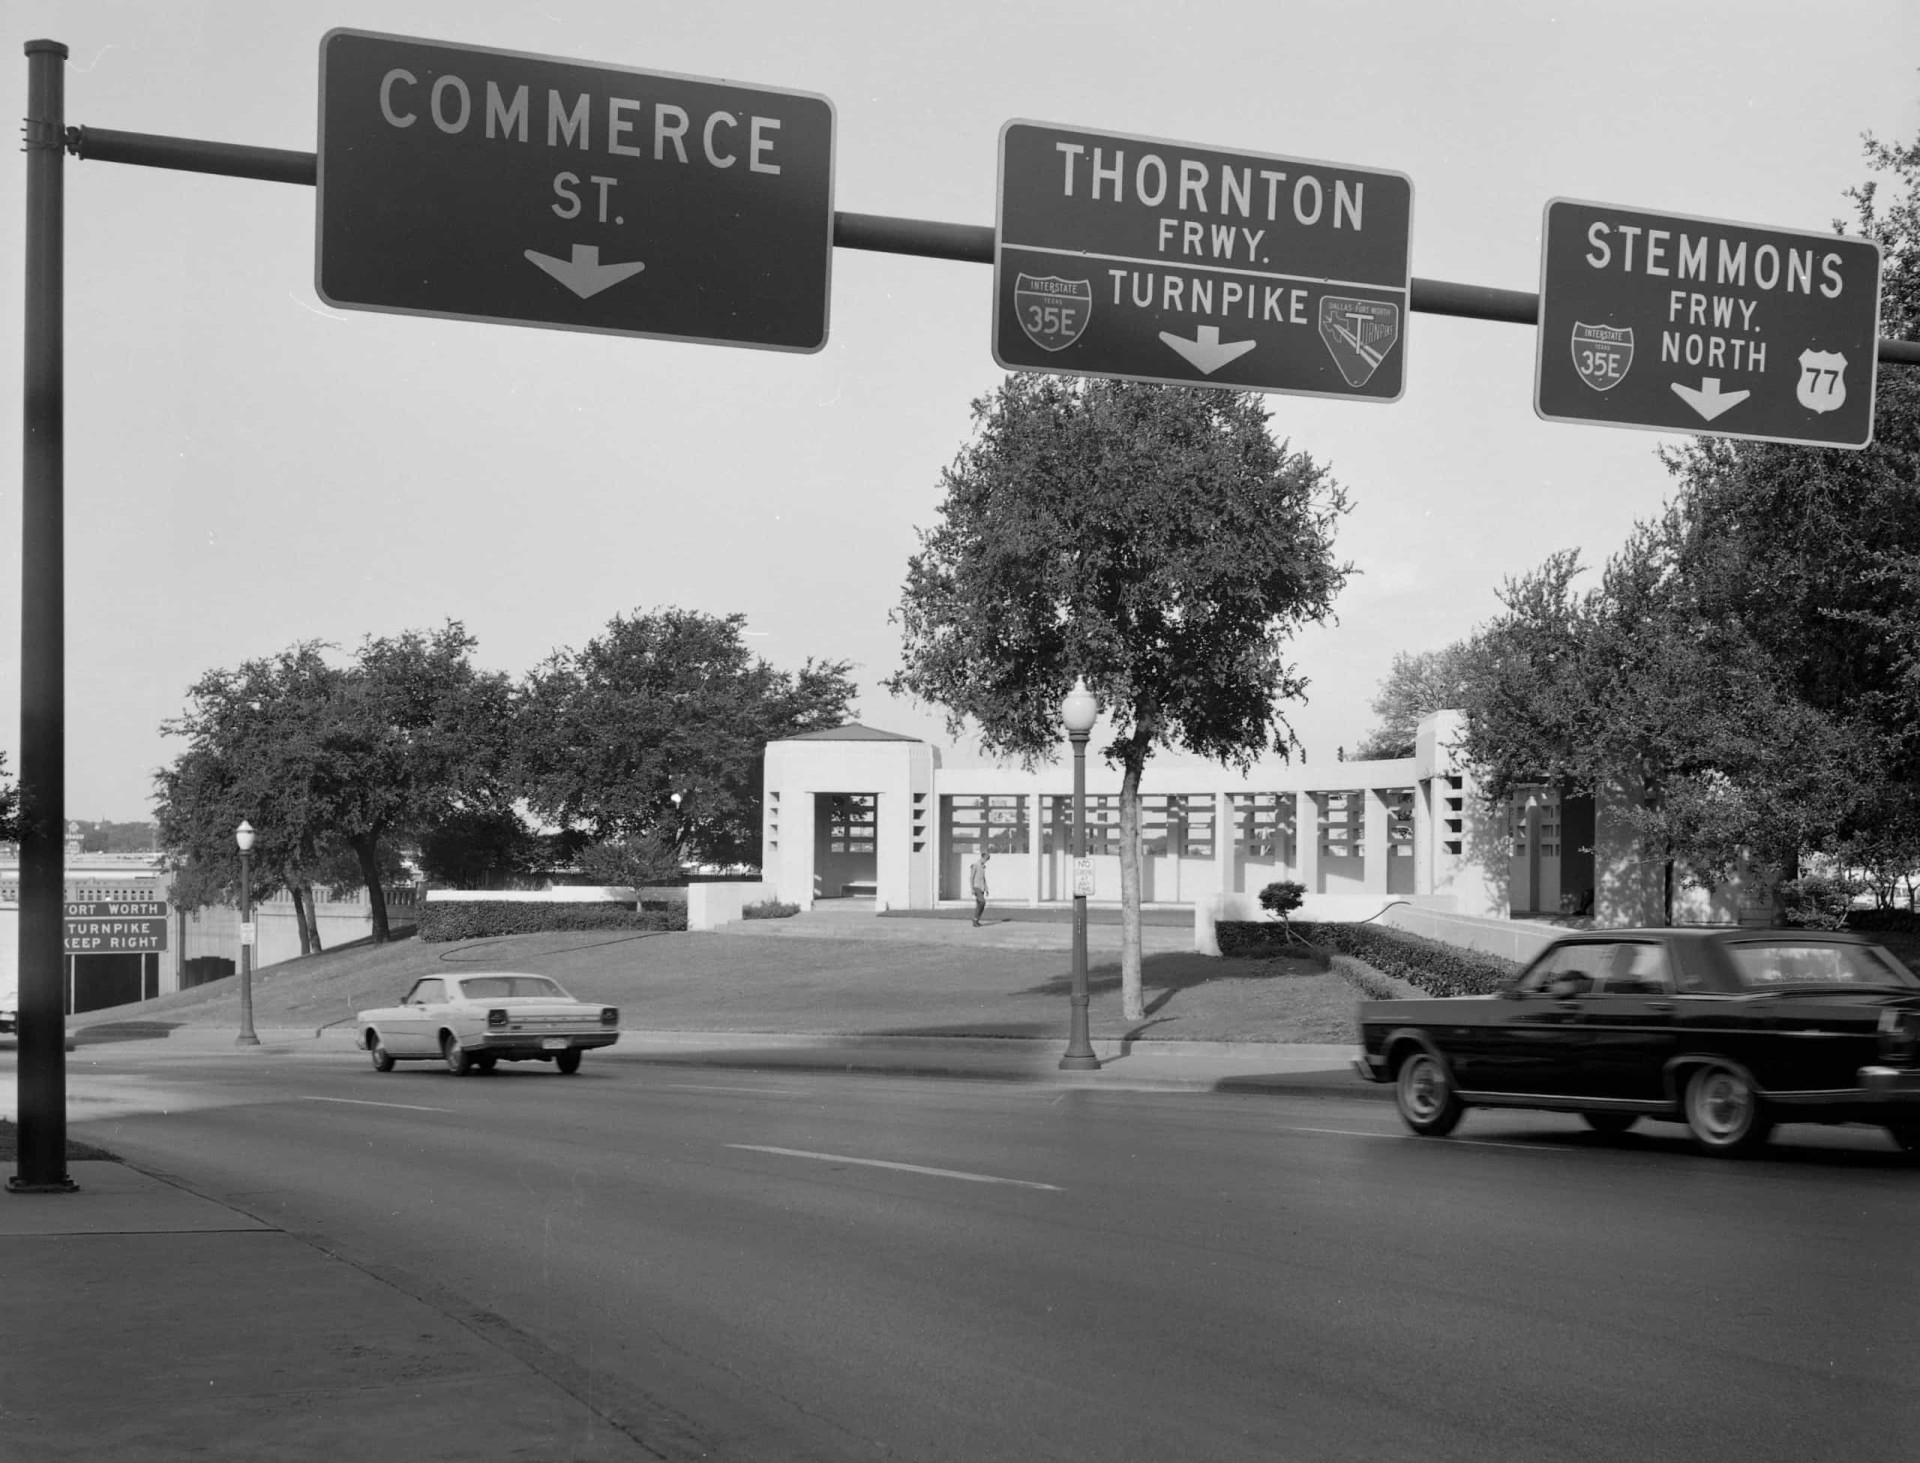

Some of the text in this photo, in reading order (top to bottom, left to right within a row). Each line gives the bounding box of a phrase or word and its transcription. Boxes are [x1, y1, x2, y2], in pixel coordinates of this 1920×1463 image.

[379, 68, 782, 175] COMMERCE
[551, 171, 625, 225] ST.
[1056, 142, 1364, 231] THORNTON
[1158, 218, 1270, 264] FRWY.
[1585, 221, 1844, 299] STEMMONS
[1030, 280, 1078, 295] INTERSTATE
[1108, 269, 1309, 325] TURNPIKE
[1027, 305, 1076, 336] 35E
[1669, 290, 1761, 333] FRWY.
[1584, 328, 1623, 342] INTERSTATE
[1661, 331, 1767, 373] NORTH
[1580, 350, 1621, 378] 35E
[1805, 367, 1840, 396] 77
[64, 903, 158, 915] ORT WORTH
[68, 922, 150, 934] TURNPIKE
[110, 936, 158, 948] RIGHT
